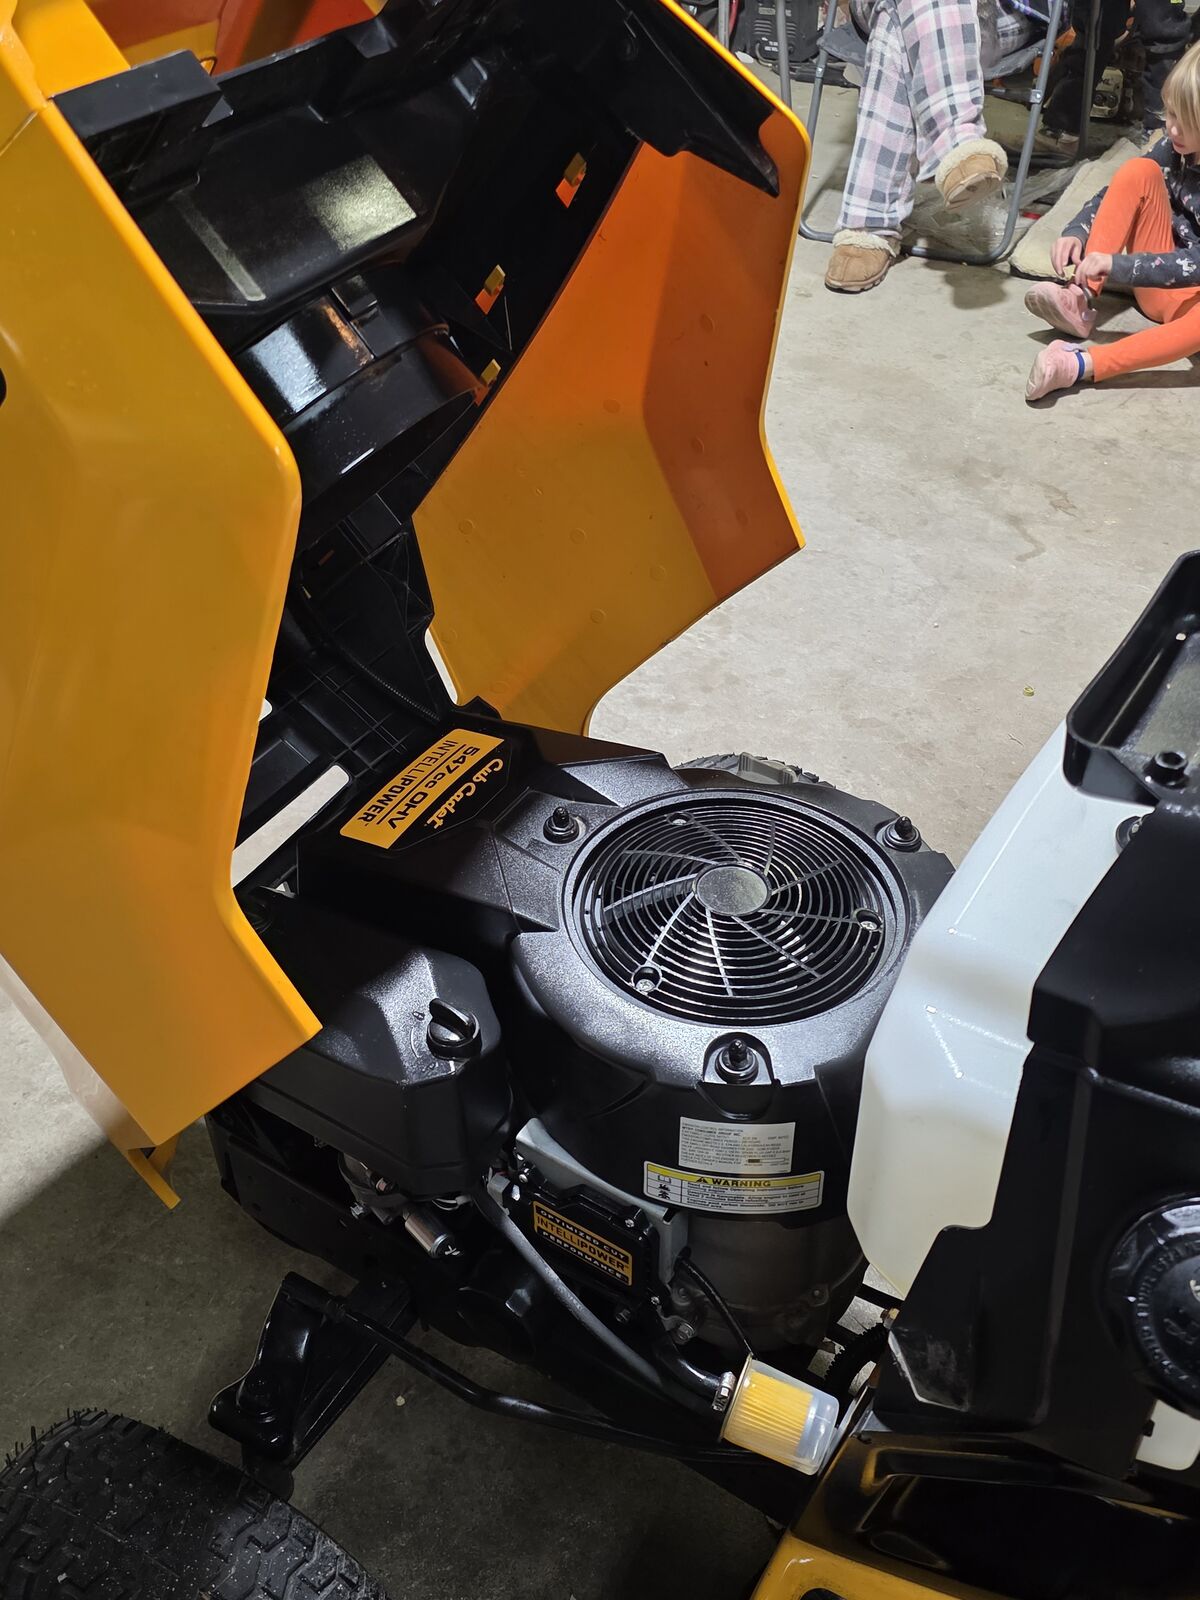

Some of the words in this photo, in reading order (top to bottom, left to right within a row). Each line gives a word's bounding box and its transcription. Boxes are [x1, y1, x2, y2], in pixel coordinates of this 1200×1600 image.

[357, 740, 459, 823] INTELLIPOWER
[472, 758, 505, 784] Cub
[386, 791, 430, 830] OHV
[425, 782, 478, 830] Cadet
[711, 1177, 771, 1188] WARNING
[536, 1216, 626, 1272] INTELLIPOWER
[539, 1208, 600, 1246] OPTIMIZED
[603, 1245, 626, 1260] CUT
[542, 1231, 624, 1279] PERFORMANCE
